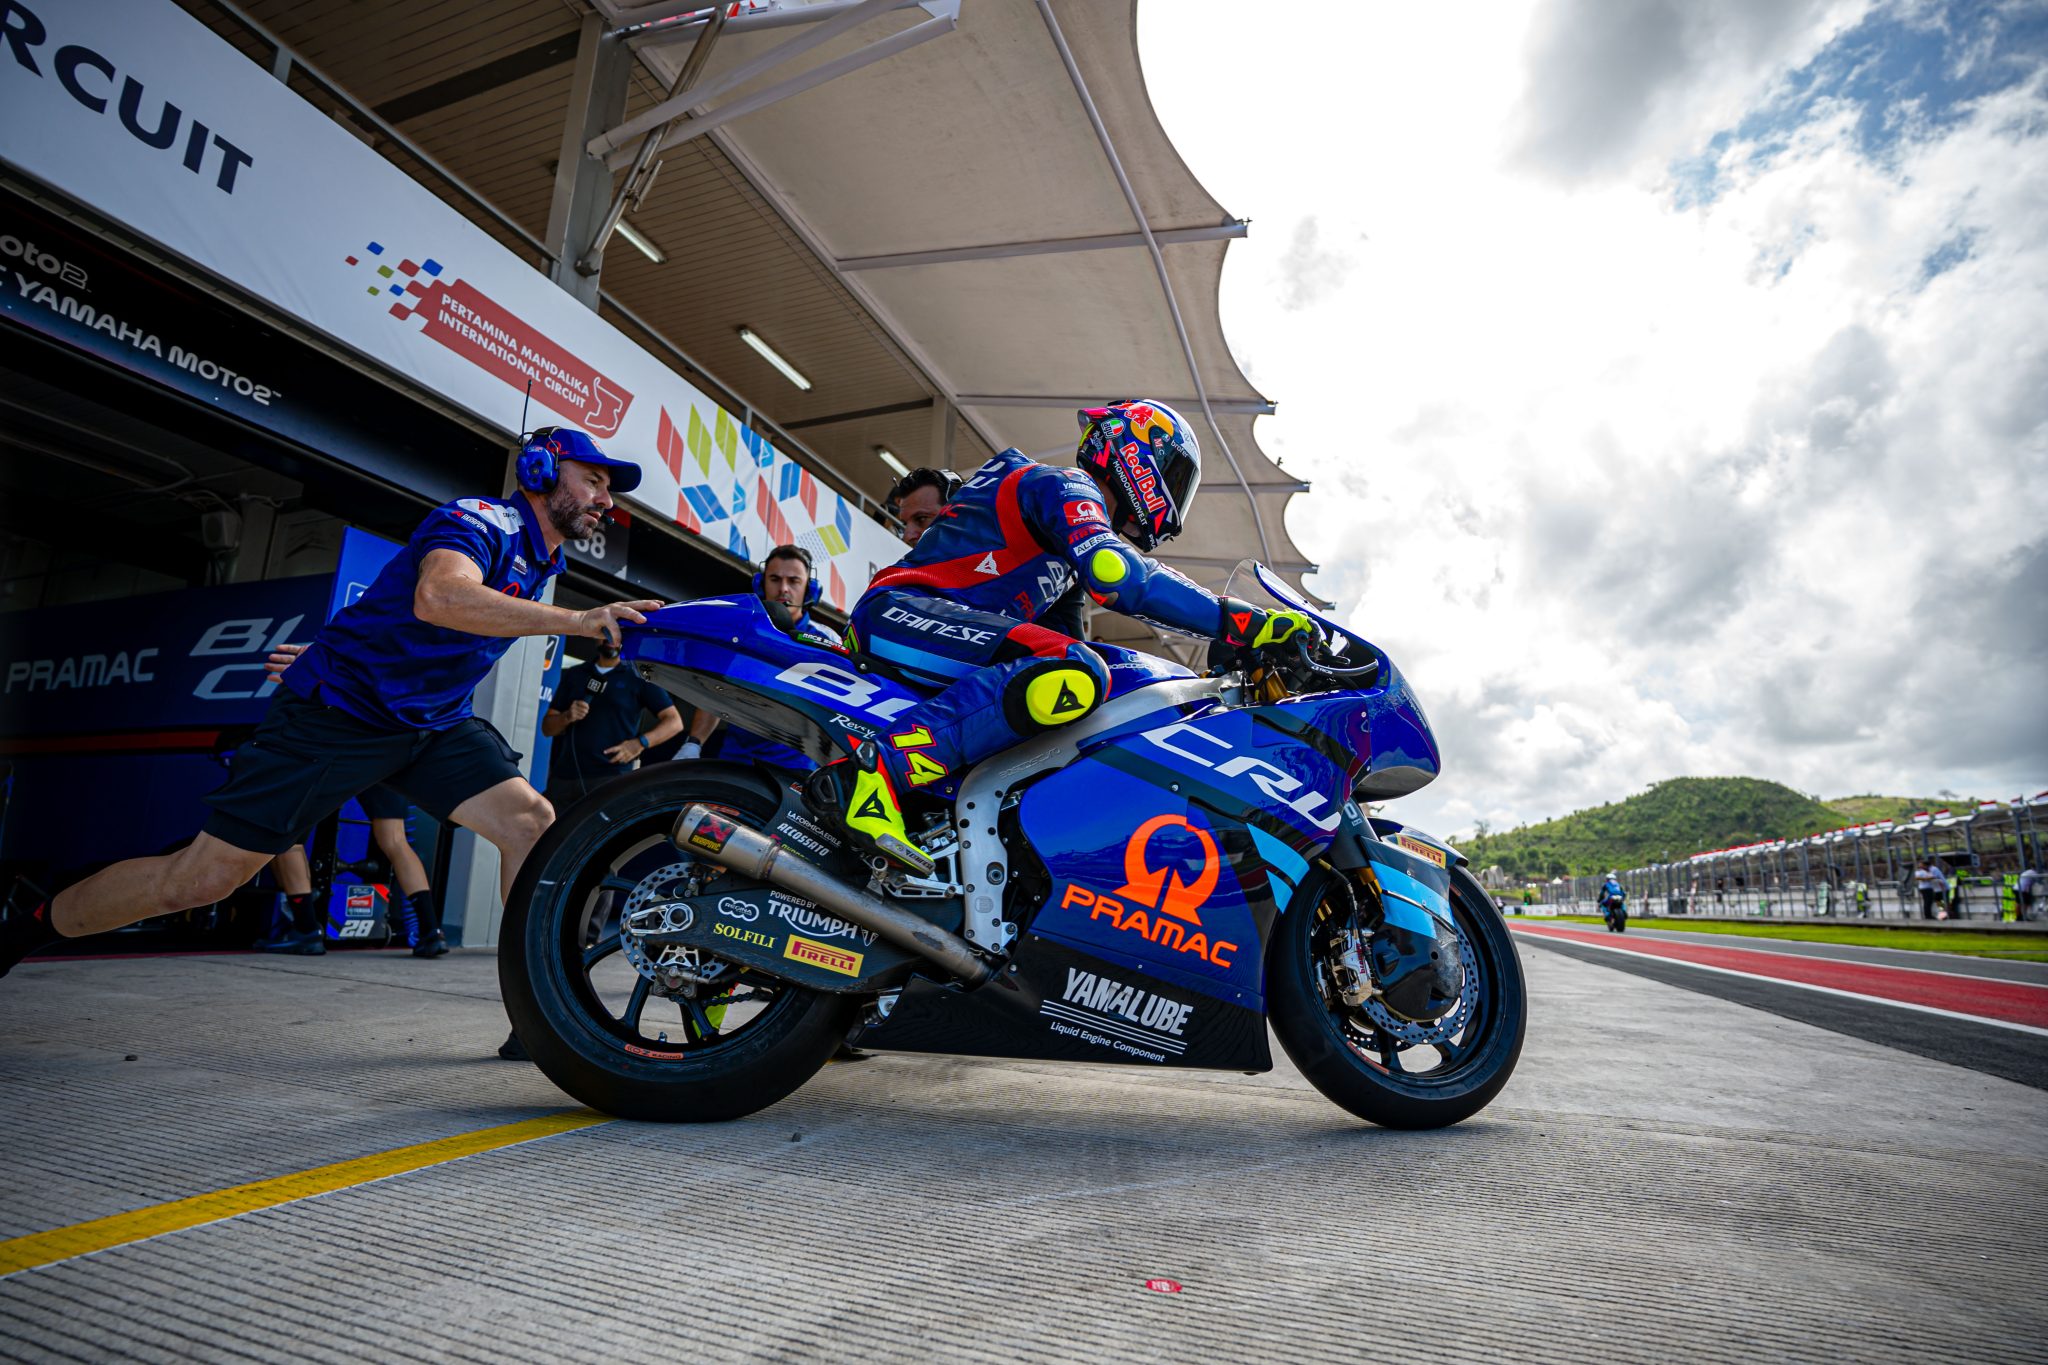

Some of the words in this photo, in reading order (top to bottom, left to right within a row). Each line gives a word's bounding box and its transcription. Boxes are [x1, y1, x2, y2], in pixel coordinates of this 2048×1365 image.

[0, 0, 253, 195] RCUIT
[15, 272, 162, 358] YAMAHA
[438, 310, 541, 382] INTERNATIONAL
[544, 377, 586, 409] CIRCUIT
[442, 293, 517, 351] PERTAMINA
[521, 346, 590, 397] MANDALIKA
[1112, 460, 1148, 526] MONDOMALDIVE.IT
[882, 606, 998, 646] DAINESE
[5, 648, 159, 694] PRAMAC
[889, 724, 949, 787] 14
[777, 823, 830, 857] ACCOSSATO
[1400, 836, 1442, 864] PIRELLI
[768, 899, 858, 940] TRIUMPH
[770, 890, 806, 906] POWERED
[806, 900, 817, 910] BY
[339, 919, 375, 937] 28
[713, 922, 776, 949] SOLFILI
[1060, 883, 1239, 969] PRAMAC
[792, 940, 856, 971] PIRELLI
[1062, 967, 1194, 1036] YAMALUBE
[1050, 1021, 1080, 1036] Liquid
[1080, 1030, 1112, 1046] Engine
[1113, 1041, 1166, 1062] Component
